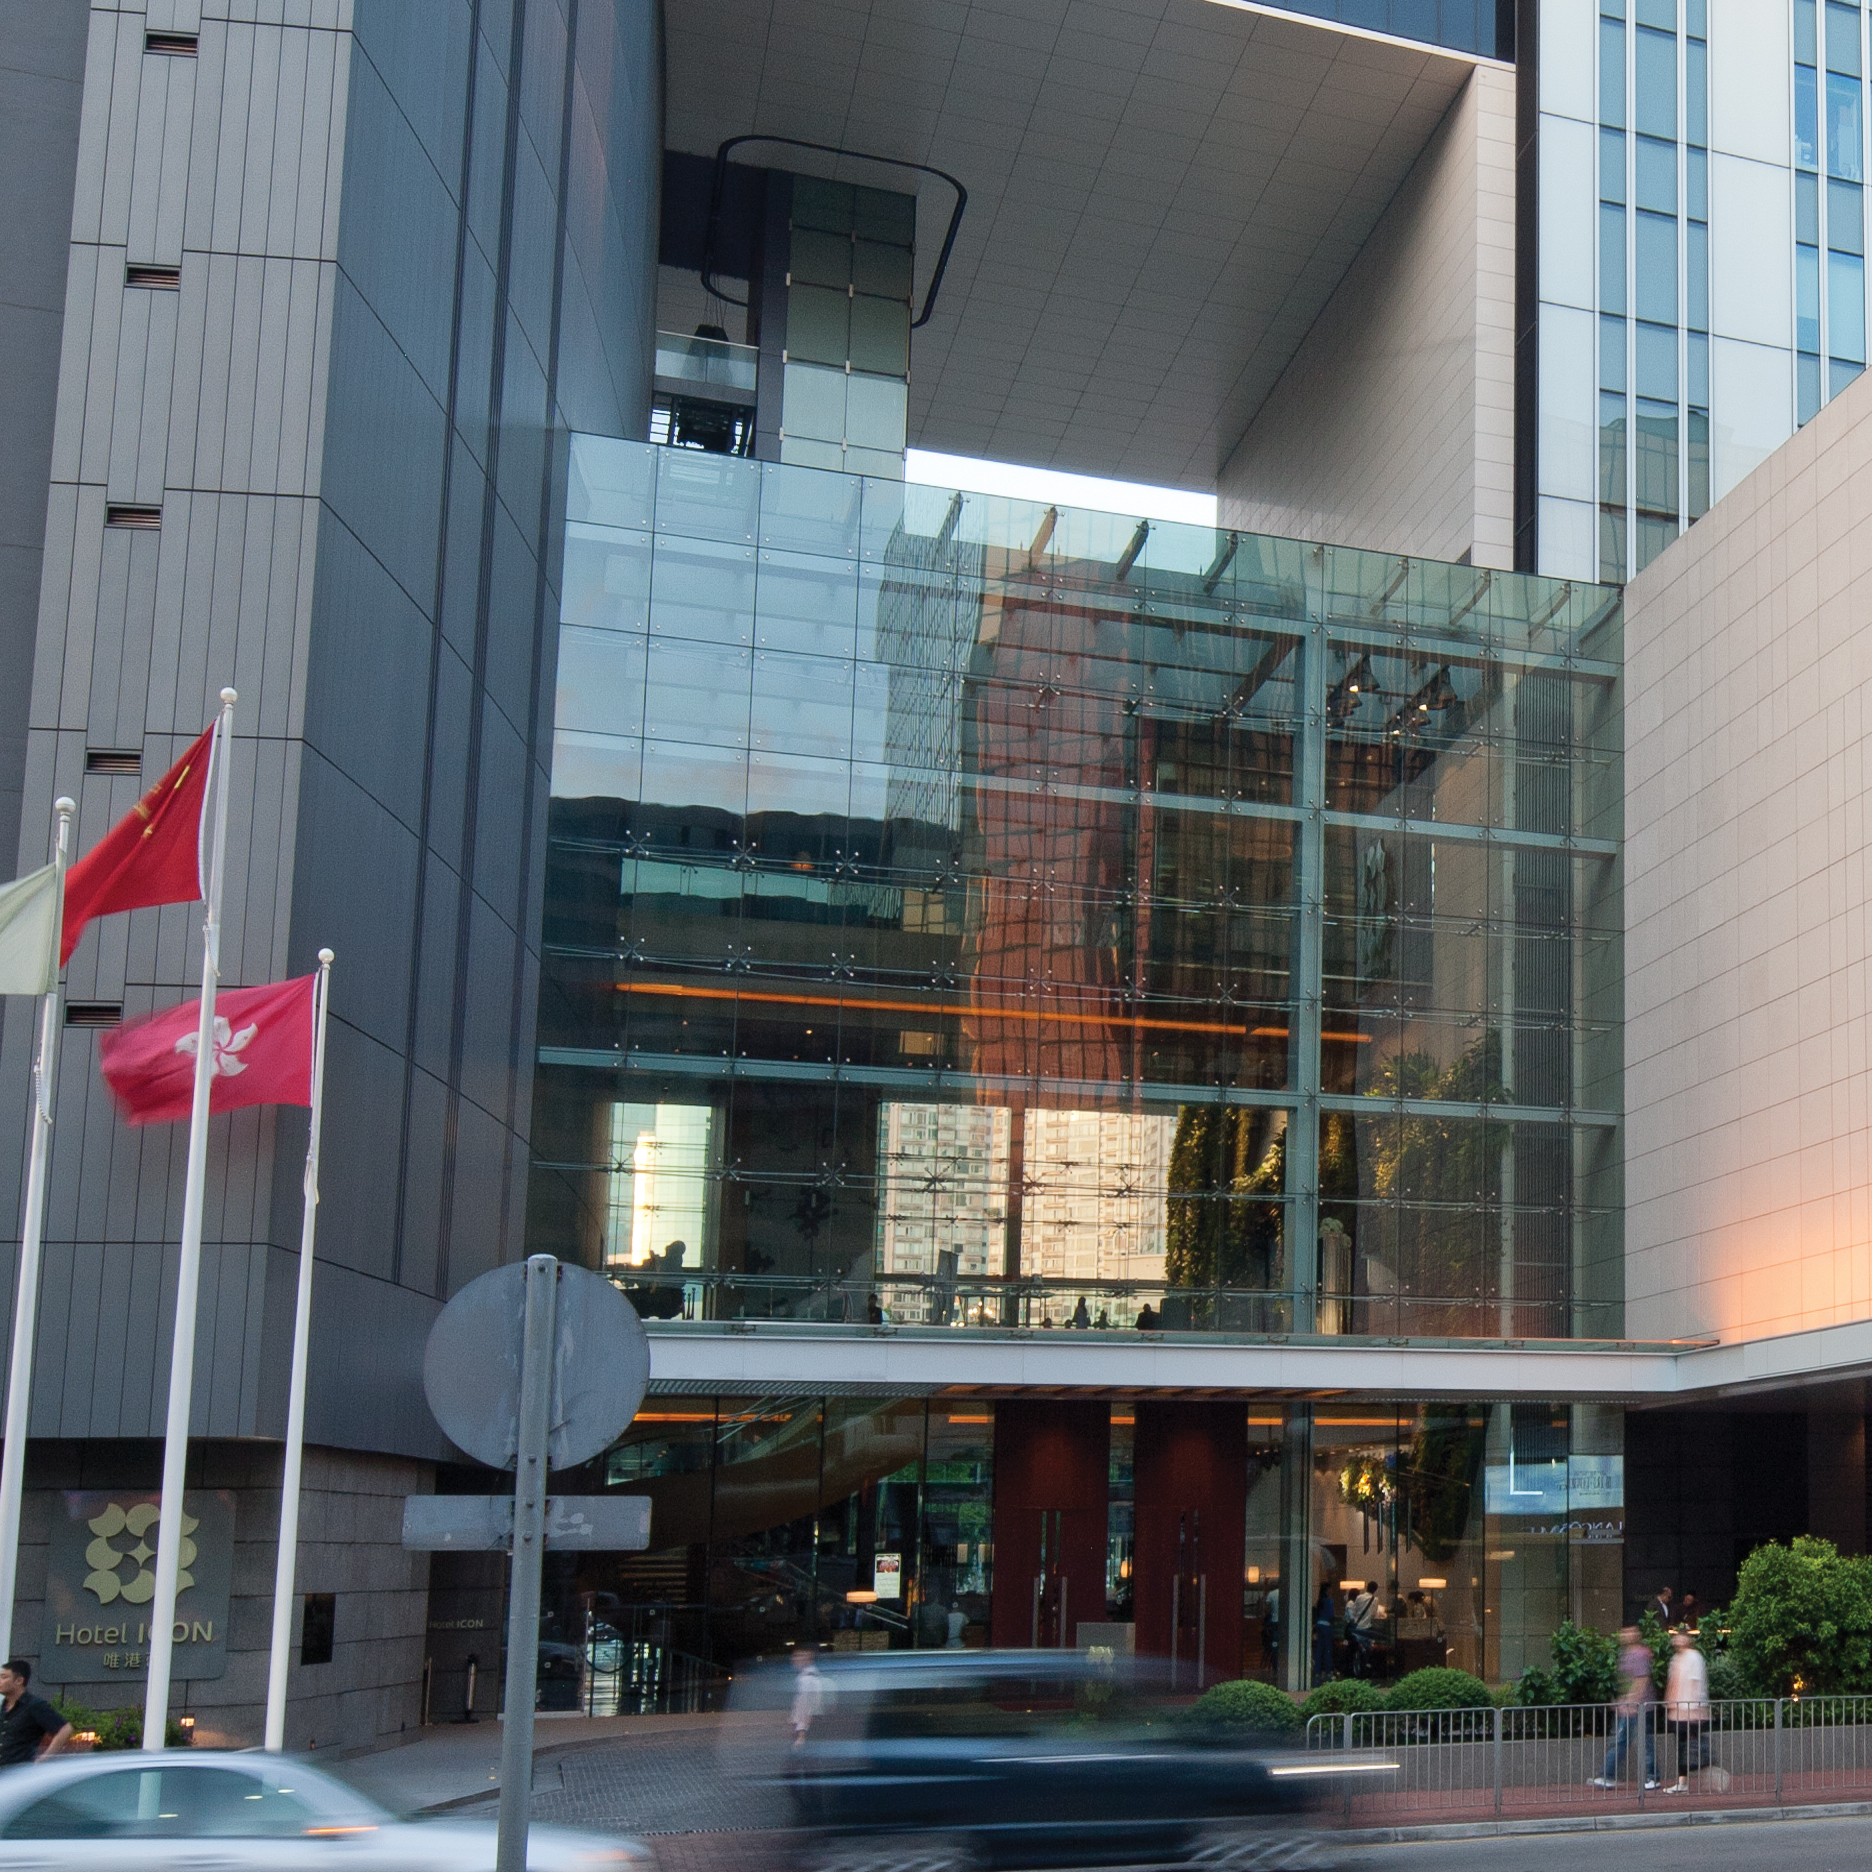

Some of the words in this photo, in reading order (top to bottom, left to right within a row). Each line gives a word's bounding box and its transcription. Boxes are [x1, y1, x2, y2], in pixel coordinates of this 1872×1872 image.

[457, 1618, 484, 1629] ICON
[55, 1622, 128, 1645] Hotel
[137, 1620, 213, 1644] ION
[103, 1652, 150, 1669] 唯港
